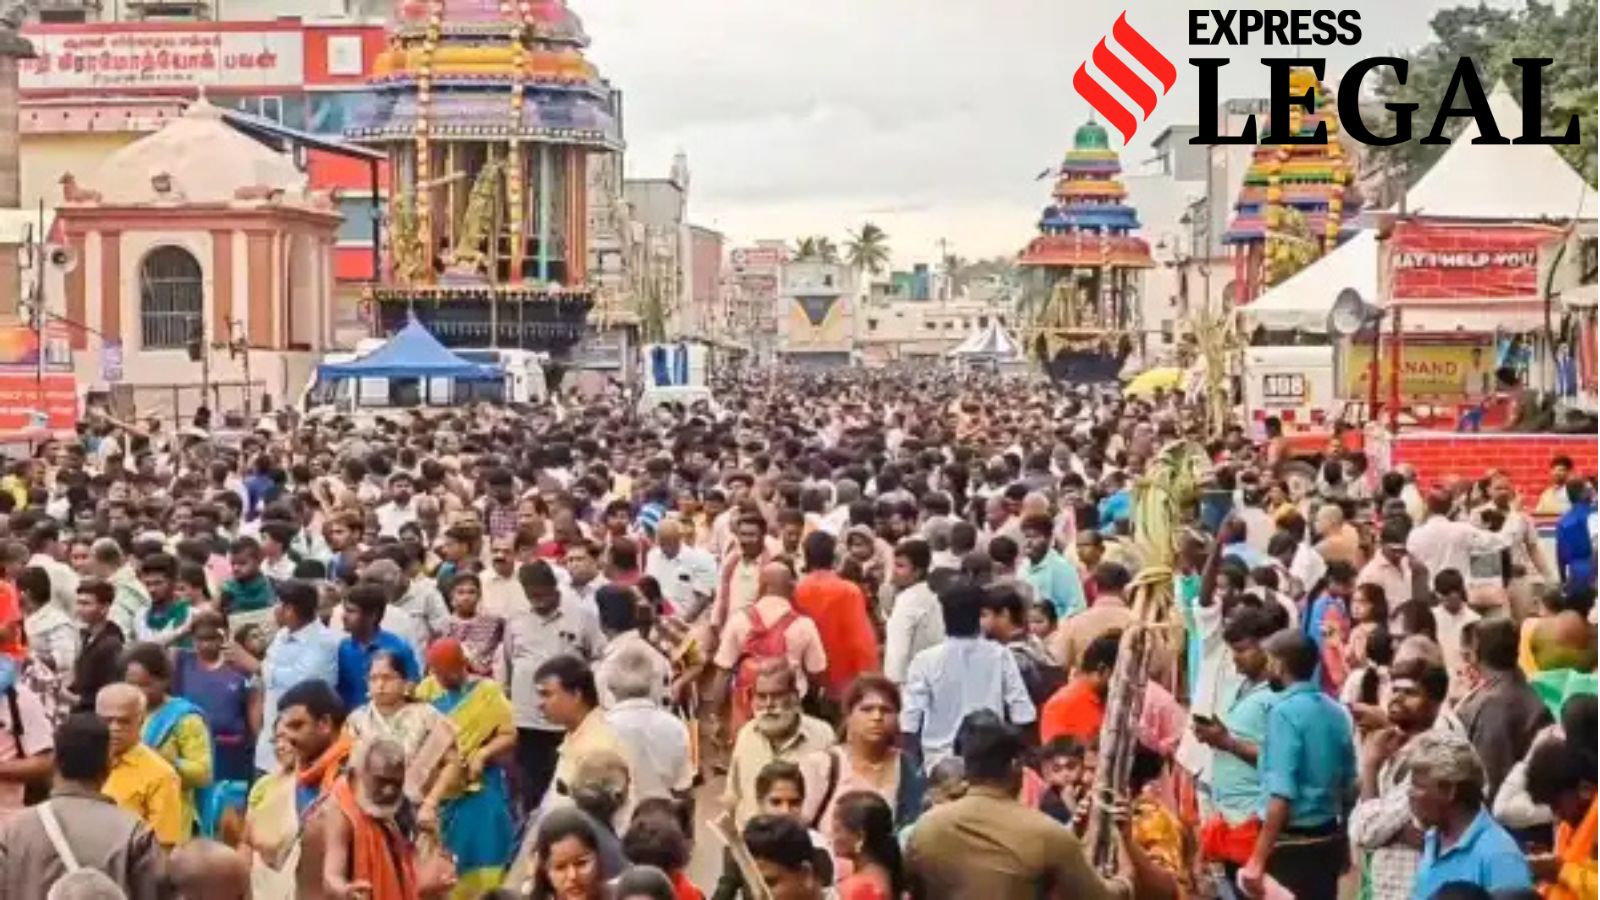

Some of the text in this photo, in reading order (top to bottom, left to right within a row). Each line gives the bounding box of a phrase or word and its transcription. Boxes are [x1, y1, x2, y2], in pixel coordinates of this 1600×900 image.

[1440, 252, 1490, 267] HELP
[1492, 251, 1538, 266] YOU
[1396, 360, 1457, 376] NAND
